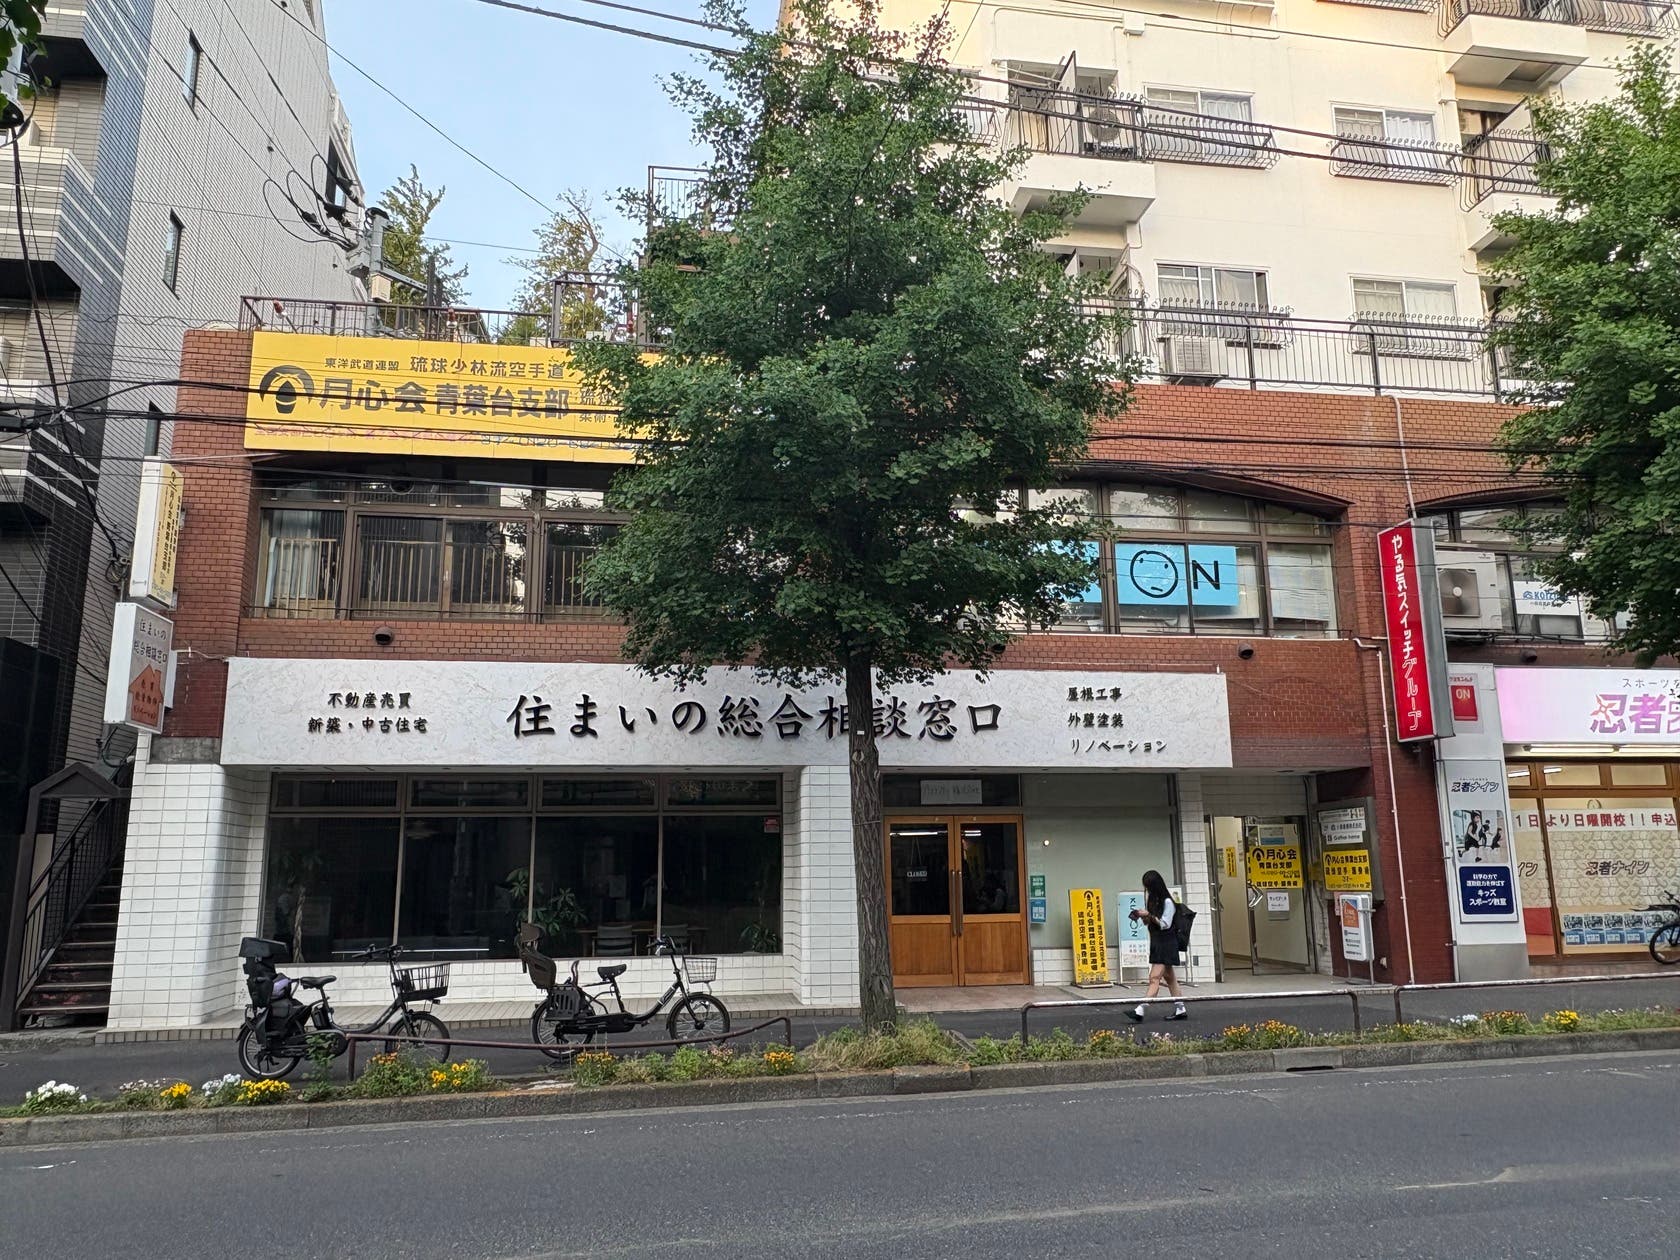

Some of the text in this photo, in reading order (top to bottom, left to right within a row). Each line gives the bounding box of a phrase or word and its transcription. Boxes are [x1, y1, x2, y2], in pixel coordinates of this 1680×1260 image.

[325, 355, 564, 379] 東洋武道連盟 琉球少林流空手道
[318, 377, 570, 420] 月心会青葉台支部
[1391, 534, 1421, 730] やる気スイッチグループ
[327, 692, 412, 709] 不動産売買
[1067, 686, 1122, 701] 屋根工事
[1455, 688, 1471, 699] ON
[308, 716, 428, 734] 新築・中古住宅
[507, 693, 1001, 741] 住まいの総合相談窓口
[1067, 711, 1125, 728] 外壁塗装
[1071, 738, 1167, 754] リノベーション
[1451, 782, 1499, 792] 忍者ナイン
[1585, 861, 1649, 876] 忍者ナイン
[1477, 888, 1497, 897] キッズ
